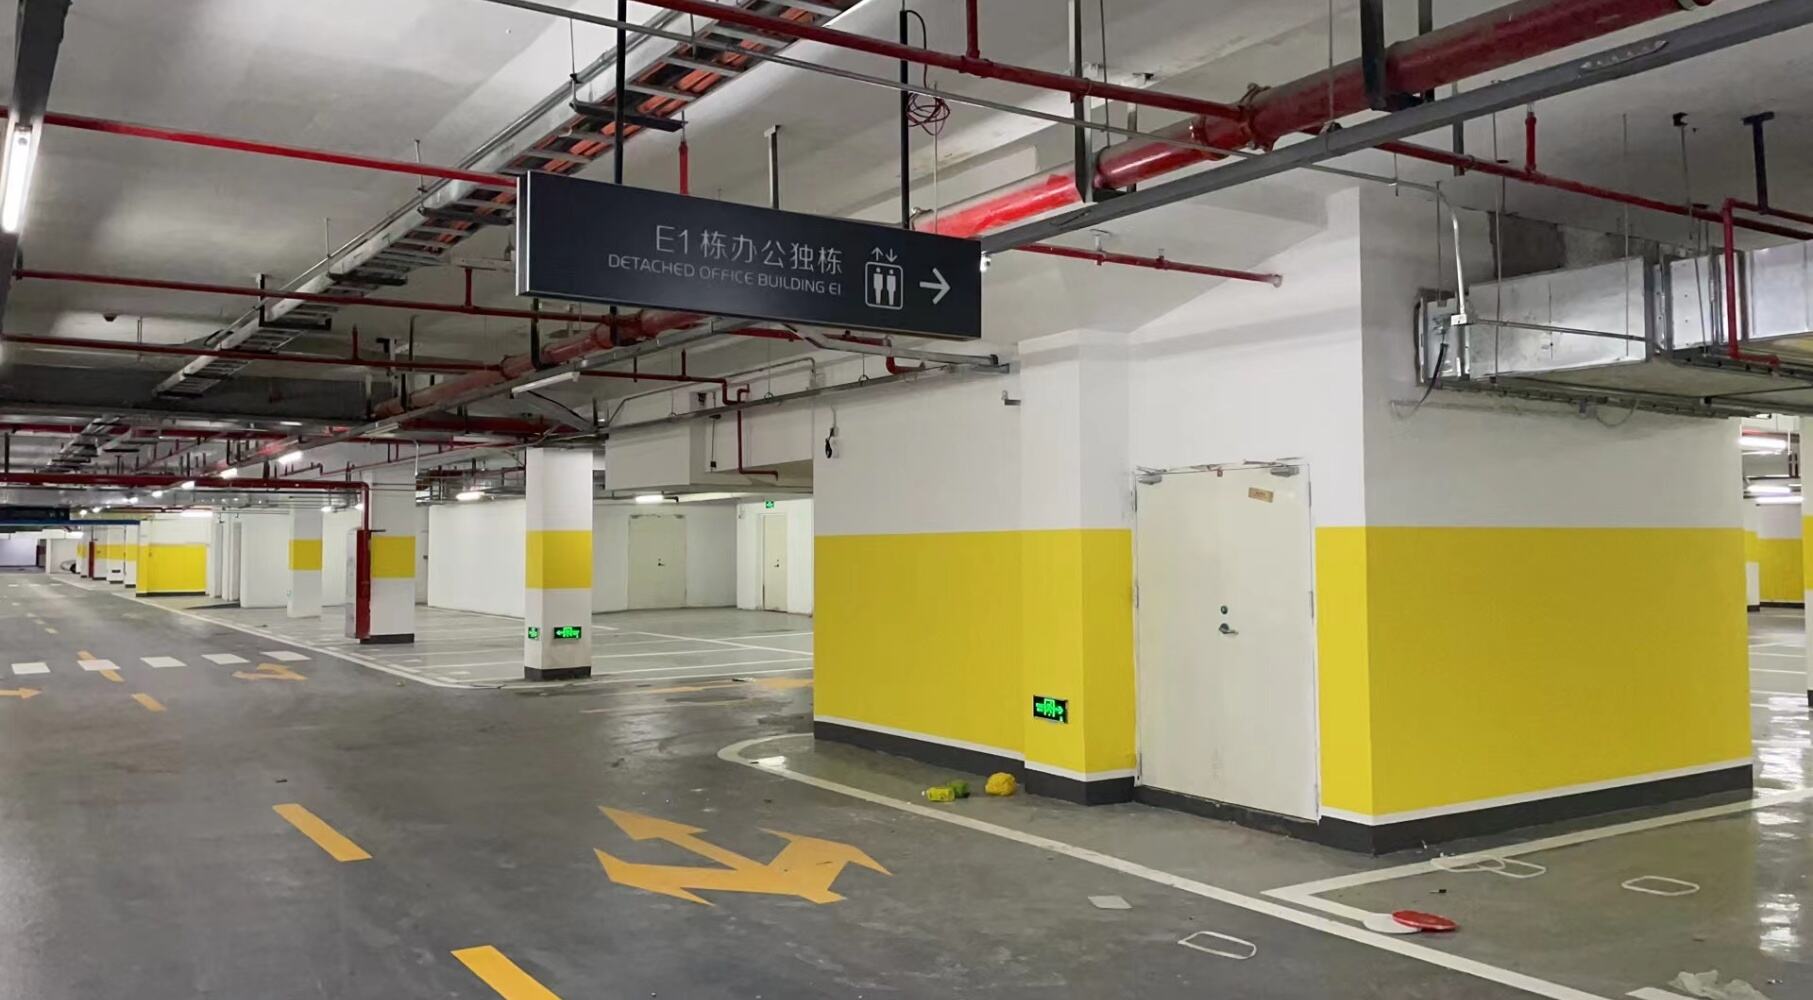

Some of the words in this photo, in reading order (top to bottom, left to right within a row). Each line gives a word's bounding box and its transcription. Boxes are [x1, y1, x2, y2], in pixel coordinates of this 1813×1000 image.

[656, 225, 689, 254] E1
[700, 229, 843, 274] 栋办公独栋
[608, 253, 696, 278] DETACHED
[700, 265, 754, 285] OFFICE
[758, 273, 825, 294] BUILDING
